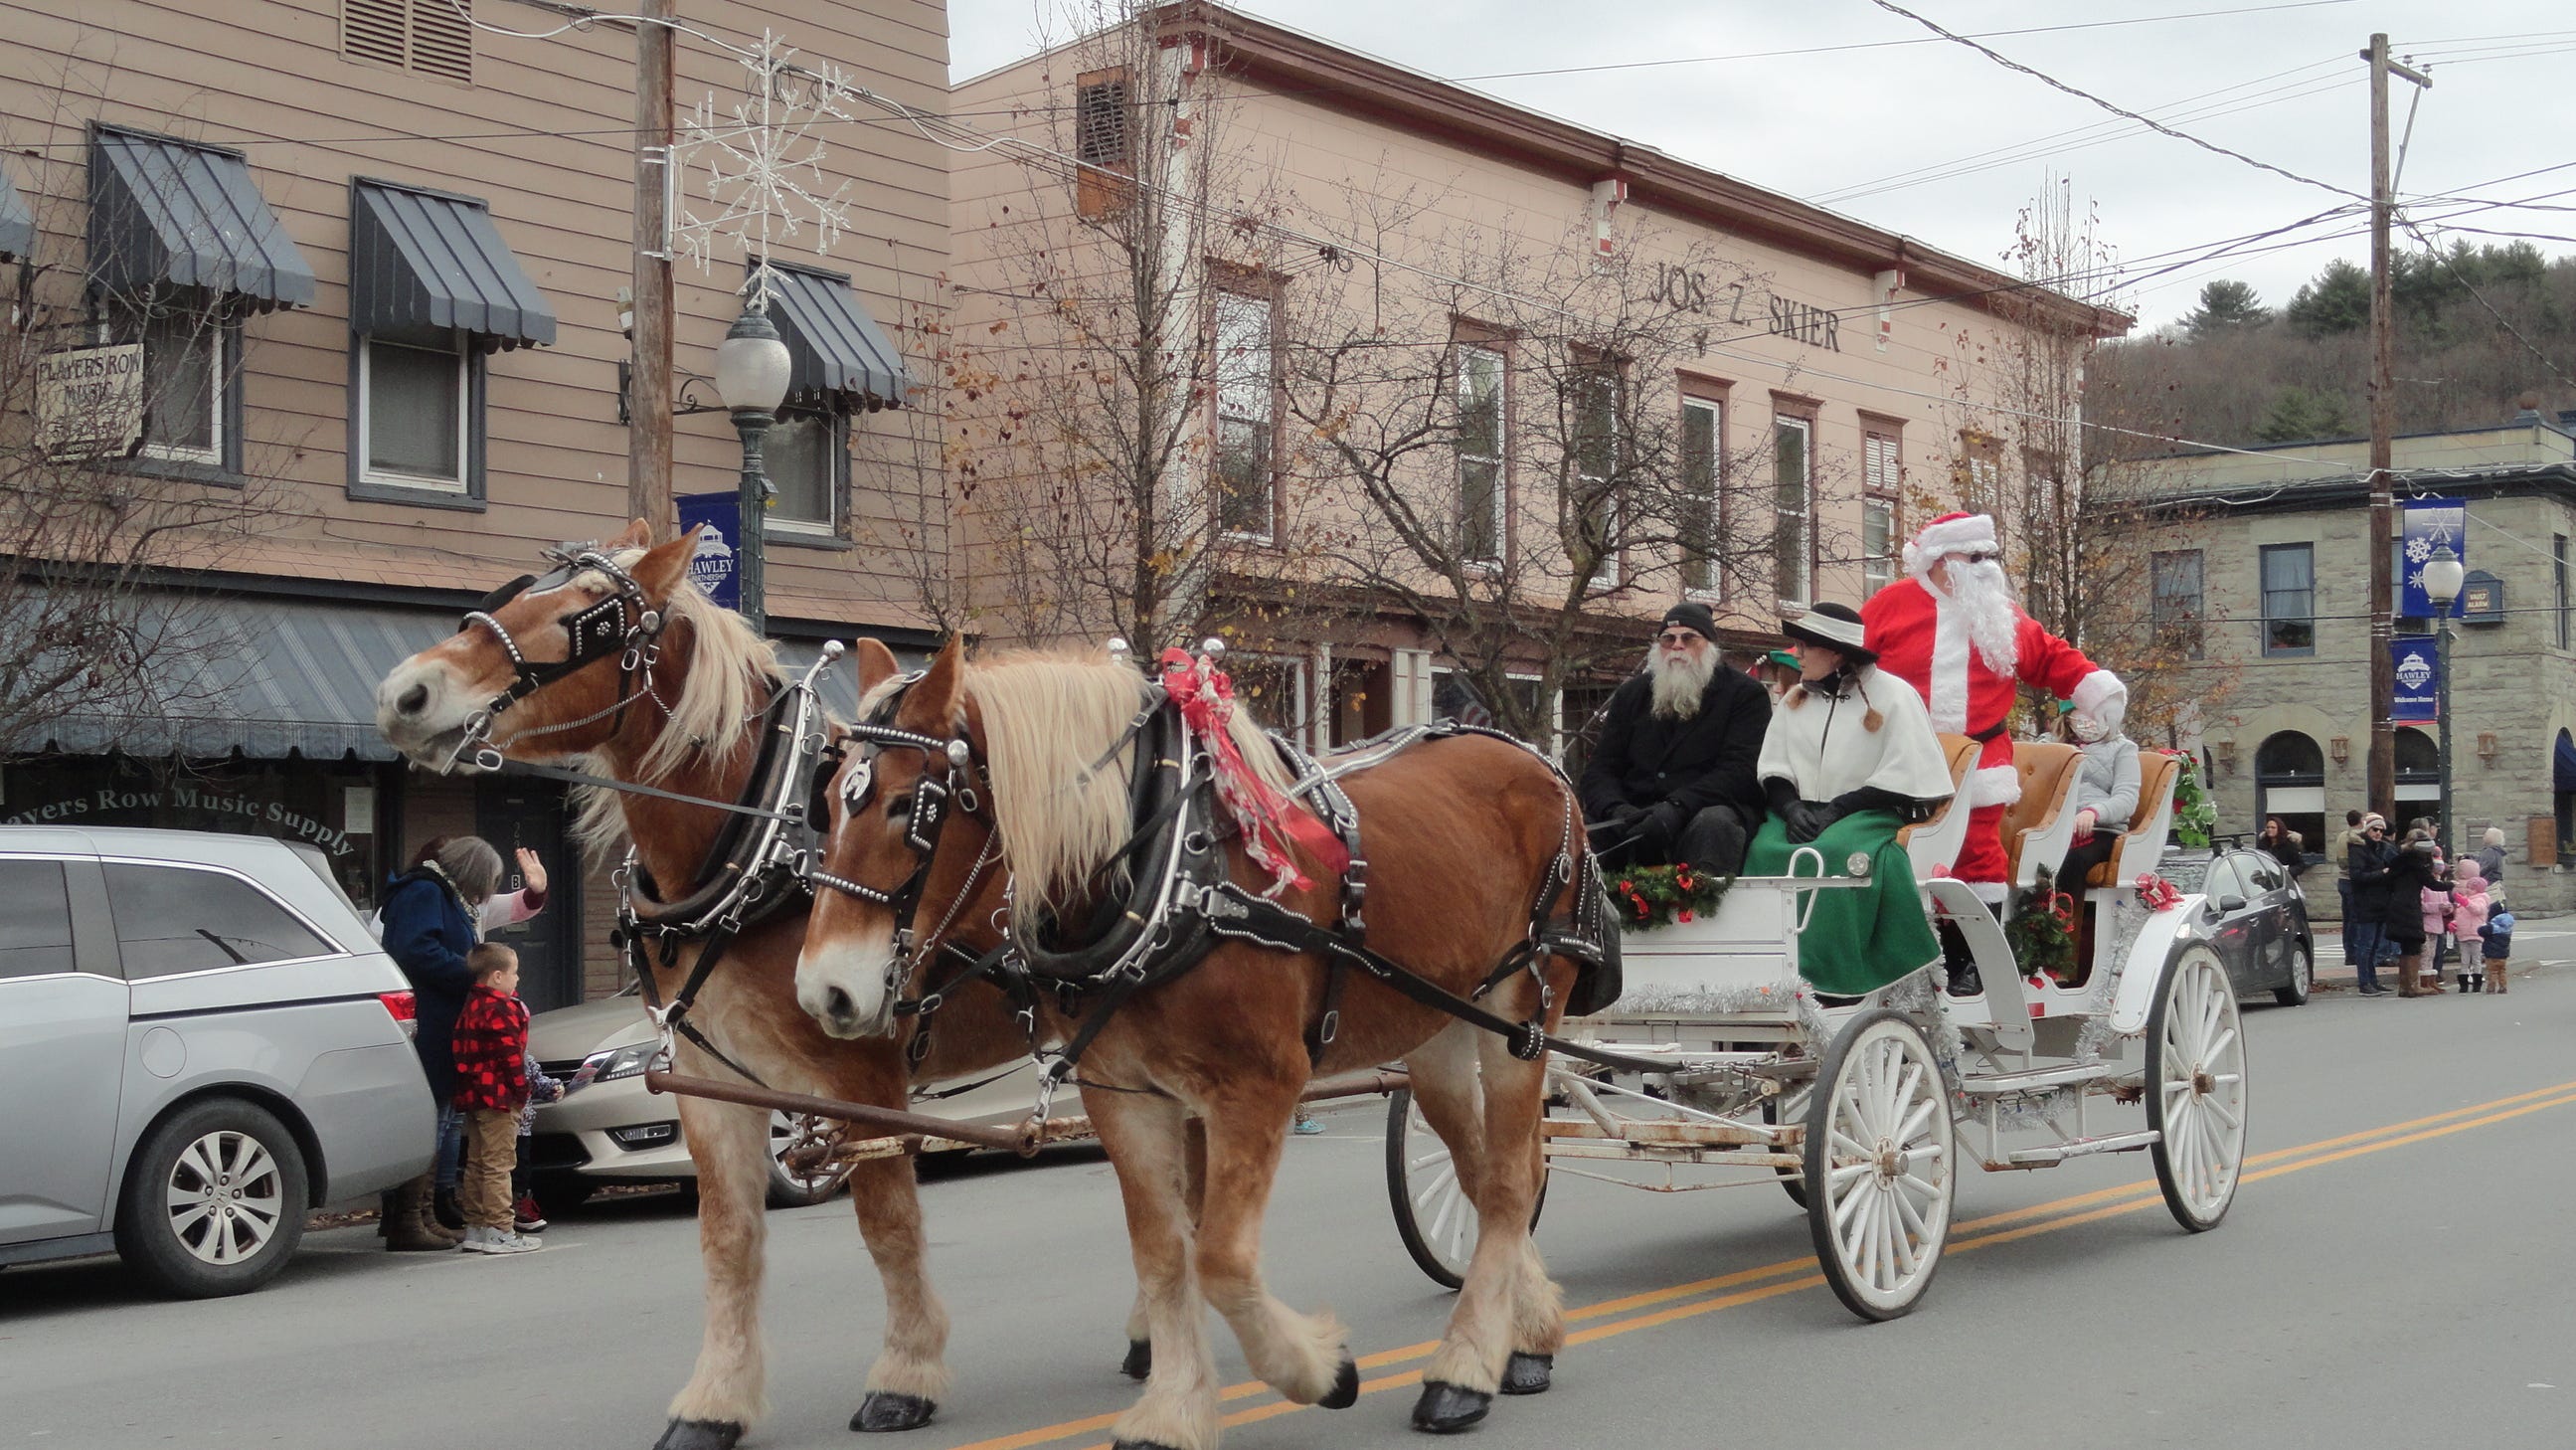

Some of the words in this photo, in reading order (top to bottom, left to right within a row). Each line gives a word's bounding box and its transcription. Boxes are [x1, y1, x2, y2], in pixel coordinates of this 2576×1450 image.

[1769, 294, 1840, 352] SKIER
[40, 357, 103, 380] PLAYERS
[108, 352, 142, 374] ROW
[2396, 671, 2432, 680] HAWLEY
[96, 789, 162, 811] Row
[172, 787, 260, 816] Music
[265, 802, 355, 856] Supply
